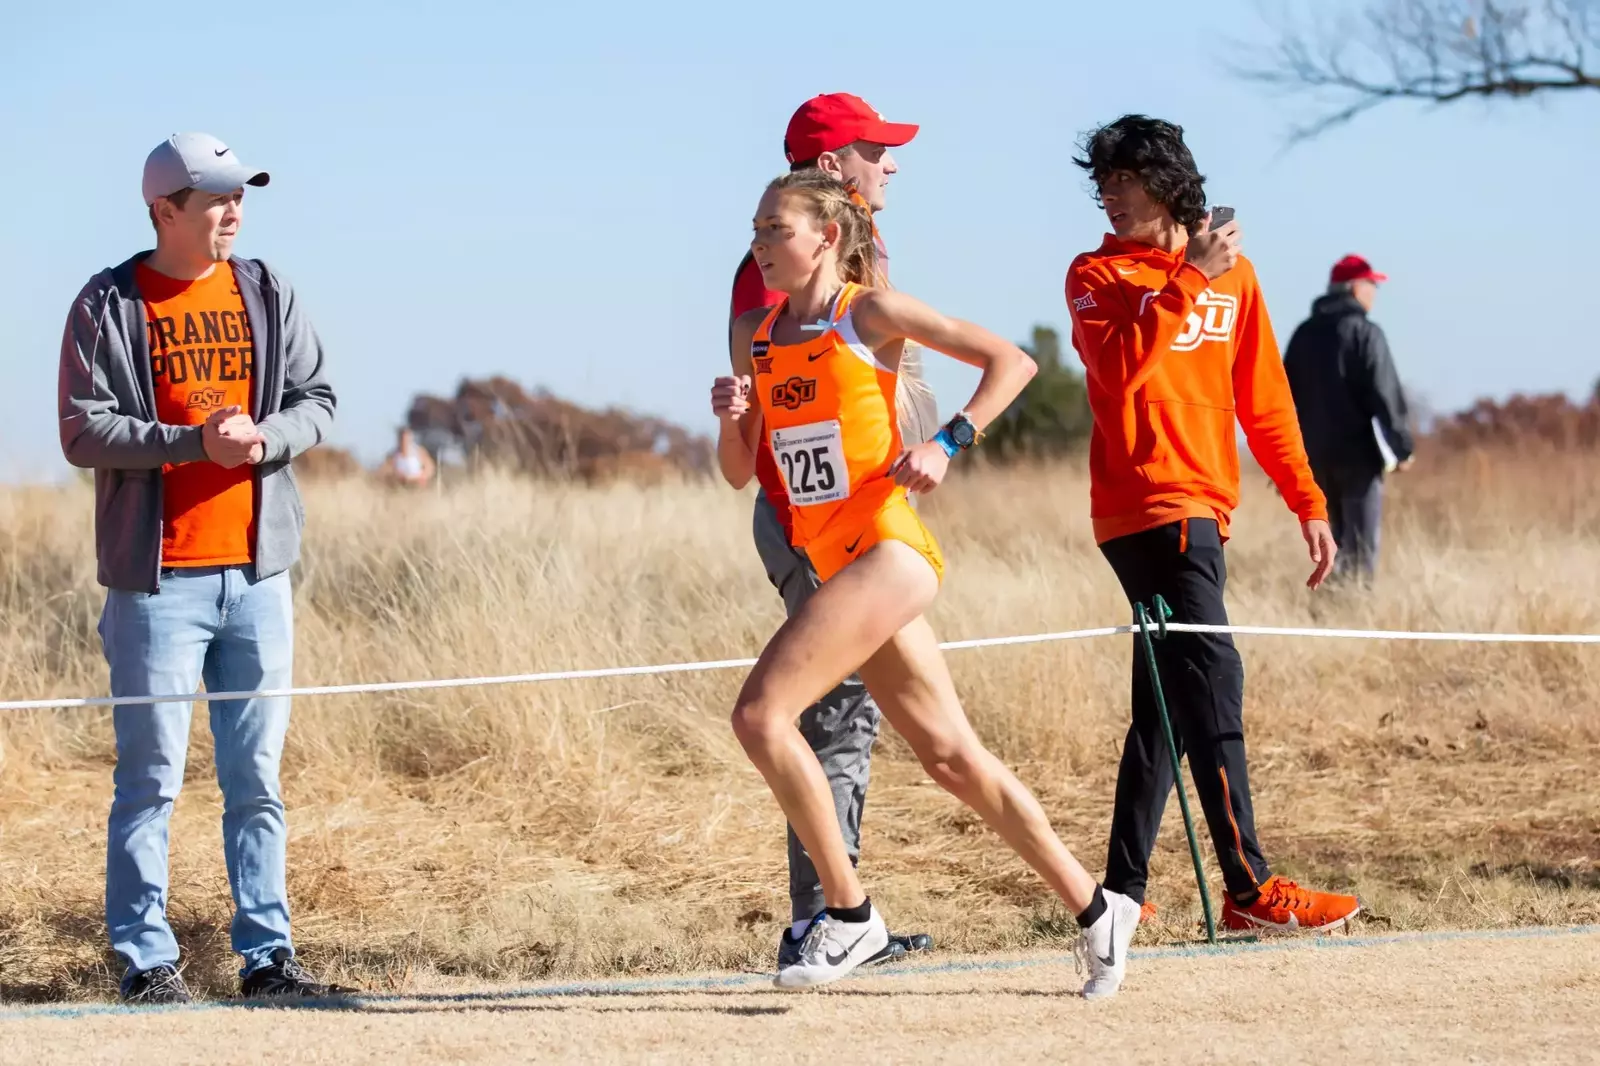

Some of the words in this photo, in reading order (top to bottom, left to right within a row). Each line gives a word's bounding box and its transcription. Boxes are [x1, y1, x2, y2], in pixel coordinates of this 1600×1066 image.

[152, 346, 253, 387] POWER
[186, 387, 227, 410] OSU
[772, 376, 817, 411] OSU
[780, 446, 836, 494] 225
